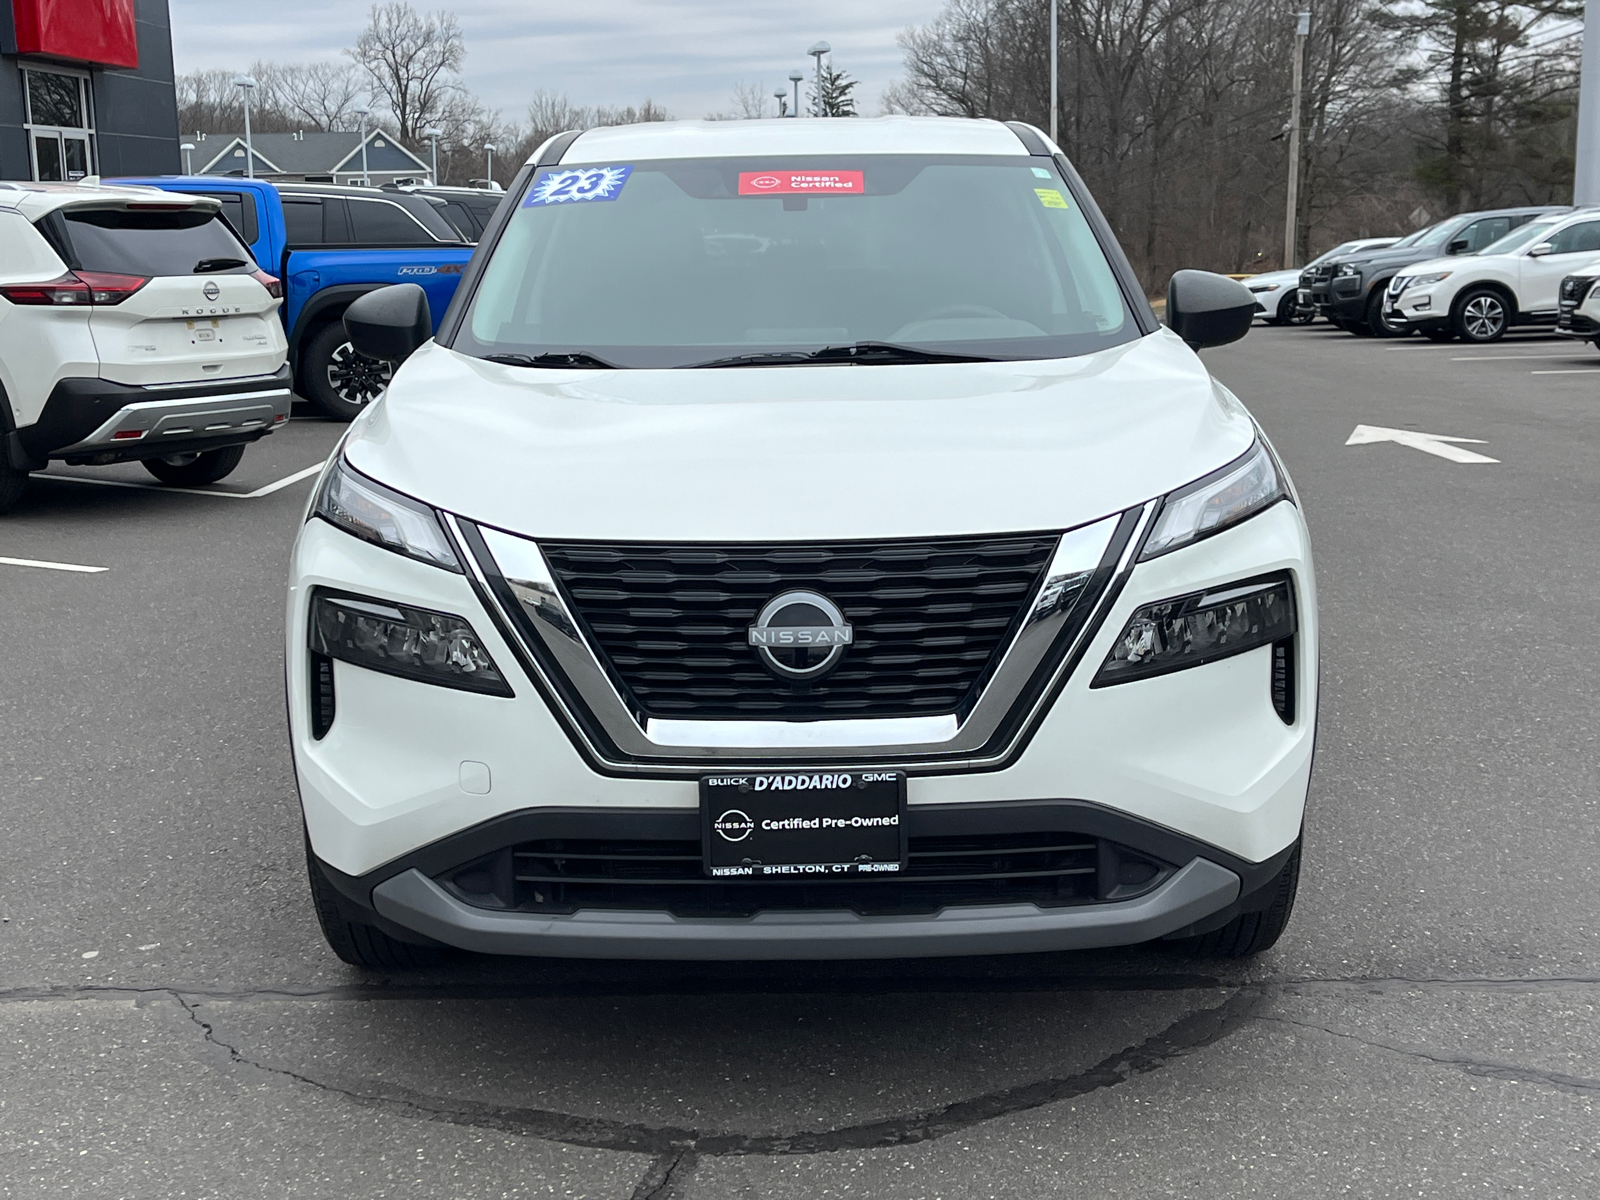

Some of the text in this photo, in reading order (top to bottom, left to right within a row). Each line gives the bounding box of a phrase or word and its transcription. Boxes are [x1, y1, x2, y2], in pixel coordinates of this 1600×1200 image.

[549, 173, 605, 196] 23
[752, 629, 840, 644] NISSAN
[708, 772, 897, 791] BUICK D'ADDARIO GMC
[714, 821, 755, 829] NISSAN
[761, 814, 900, 830] Certified Pre-Owned
[712, 863, 900, 876] NISSAN SHELTON, CT PRE-OWNED
